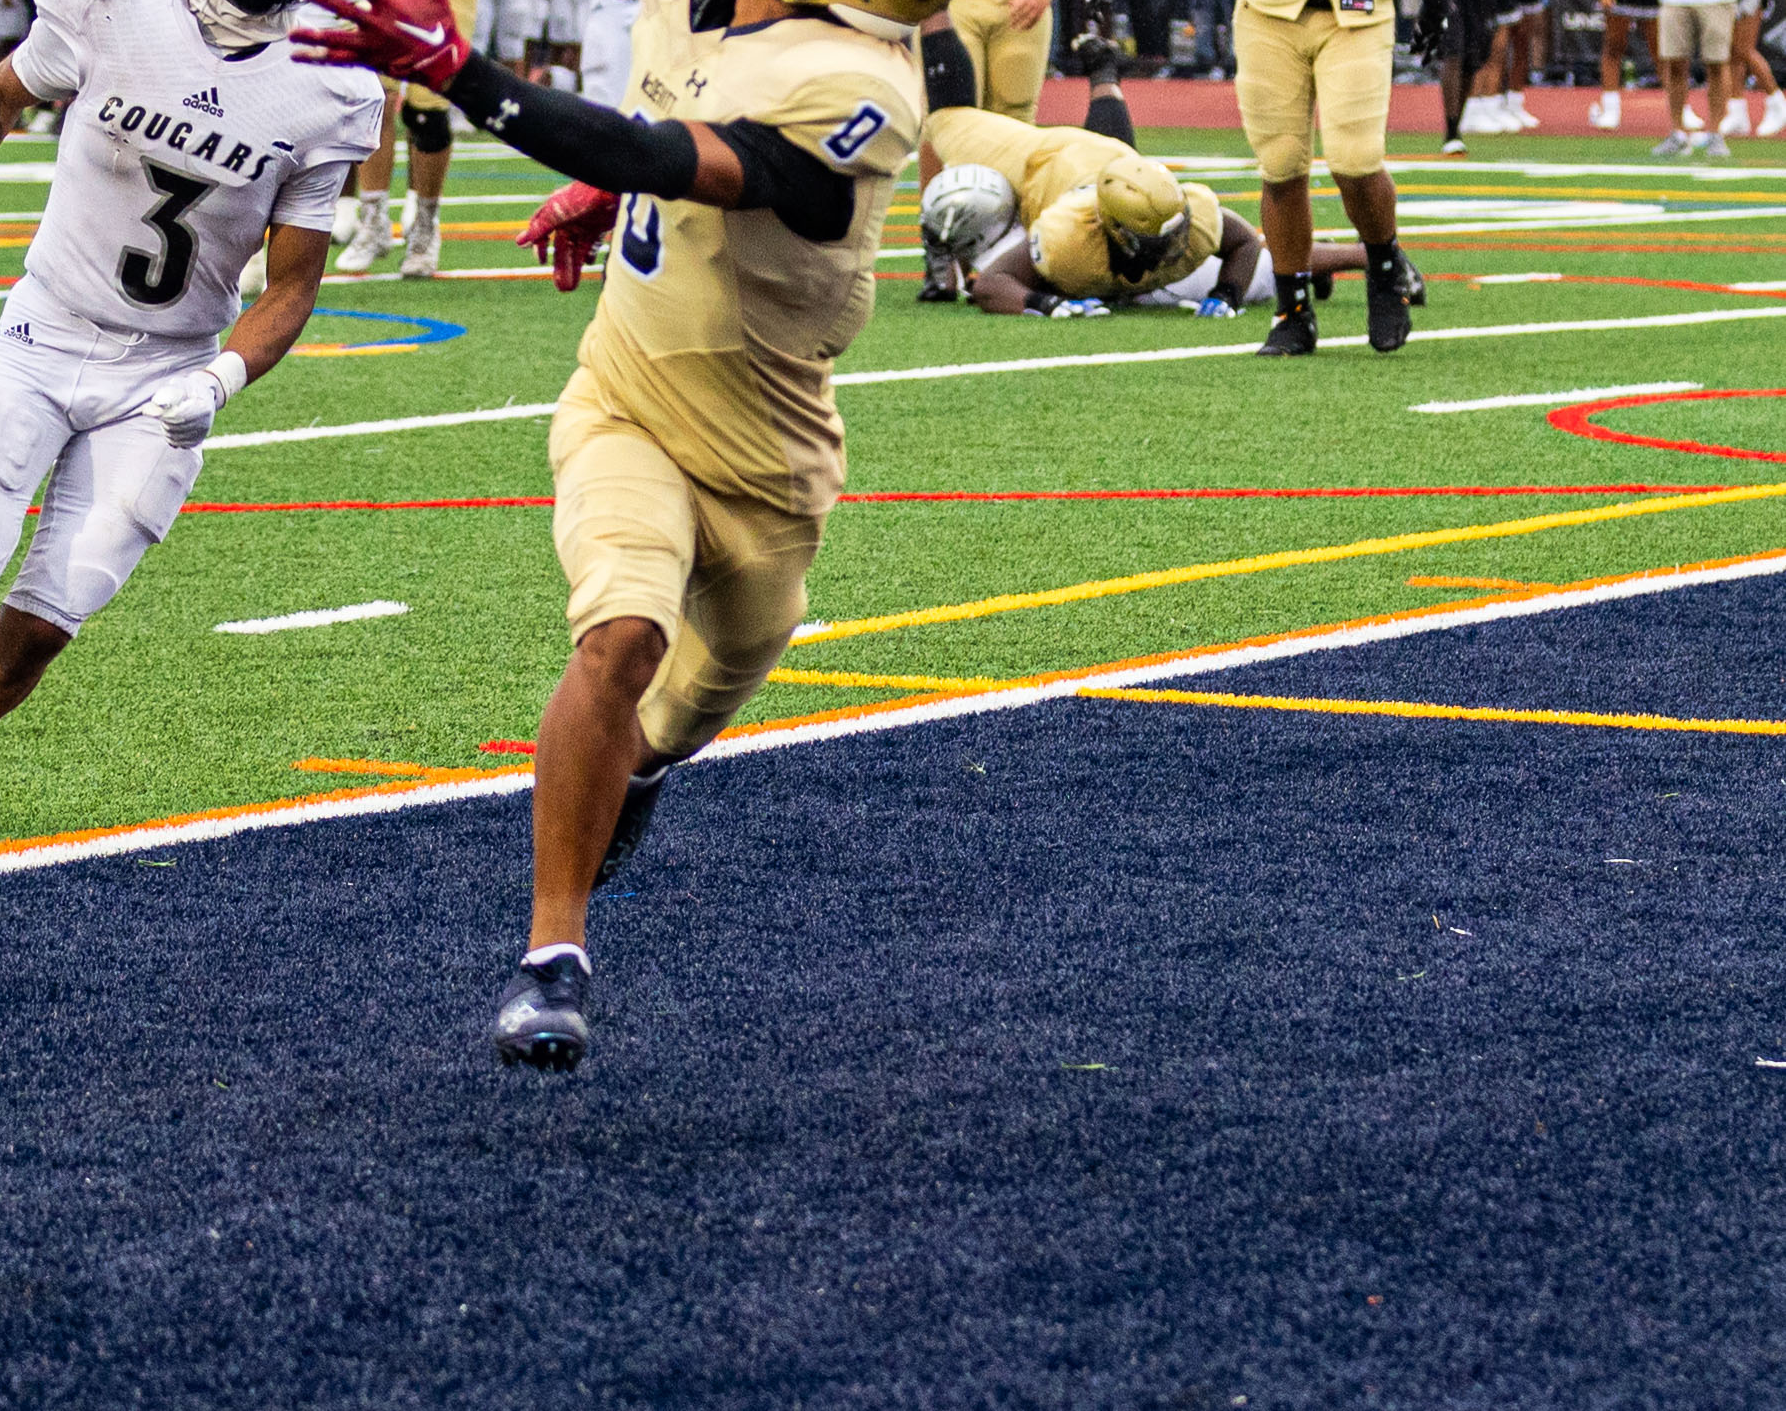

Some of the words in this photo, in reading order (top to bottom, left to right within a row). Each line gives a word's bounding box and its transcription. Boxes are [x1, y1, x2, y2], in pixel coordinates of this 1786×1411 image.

[98, 96, 276, 182] COUGARS
[182, 95, 225, 119] adidas
[820, 99, 891, 166] 0
[115, 155, 220, 312] 3
